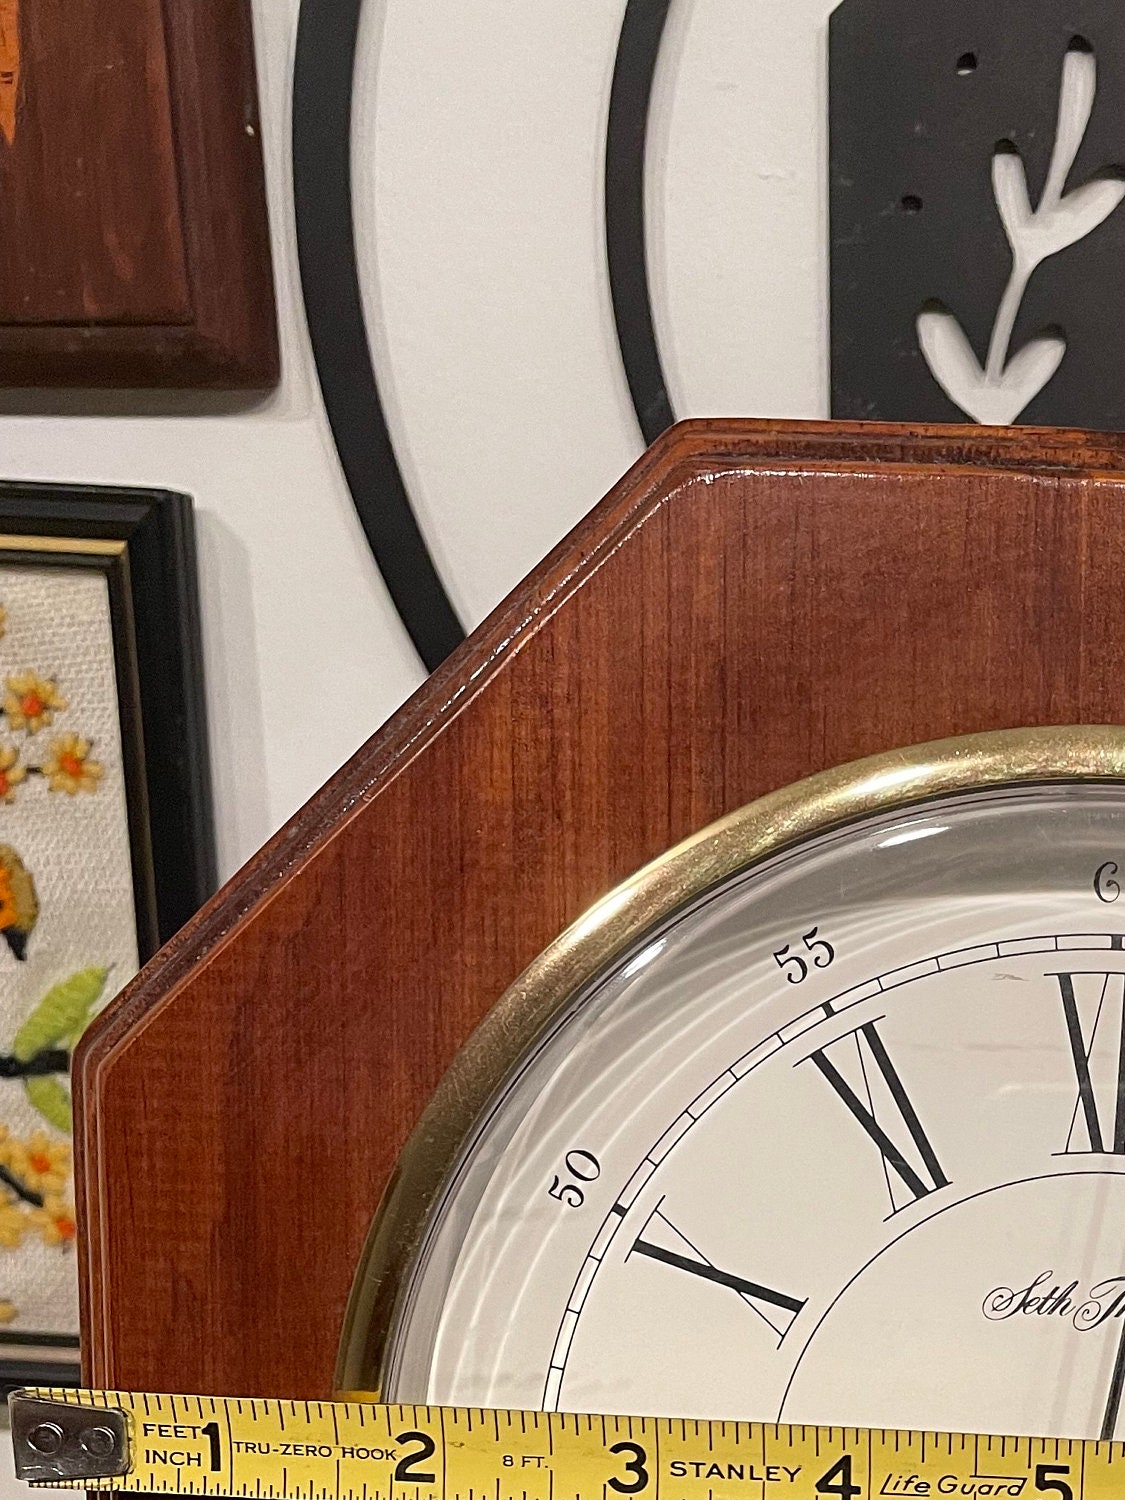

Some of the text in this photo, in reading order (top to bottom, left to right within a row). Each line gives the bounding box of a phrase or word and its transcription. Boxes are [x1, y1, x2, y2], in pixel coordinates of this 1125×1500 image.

[772, 926, 835, 984] 55
[792, 1014, 954, 1222] XI
[547, 1149, 601, 1208] 50
[624, 1194, 810, 1350] X
[981, 1269, 1076, 1321] Seth
[142, 1423, 201, 1441] FEET
[200, 1421, 221, 1472] 1
[233, 1440, 397, 1463] TRU-ZERO HOOK
[393, 1431, 436, 1484] 2
[144, 1449, 202, 1468] INCH
[502, 1454, 549, 1470] 8 FT.
[607, 1441, 649, 1495] 3
[669, 1460, 801, 1484] STANLEY
[879, 1472, 1027, 1498] Life Guard
